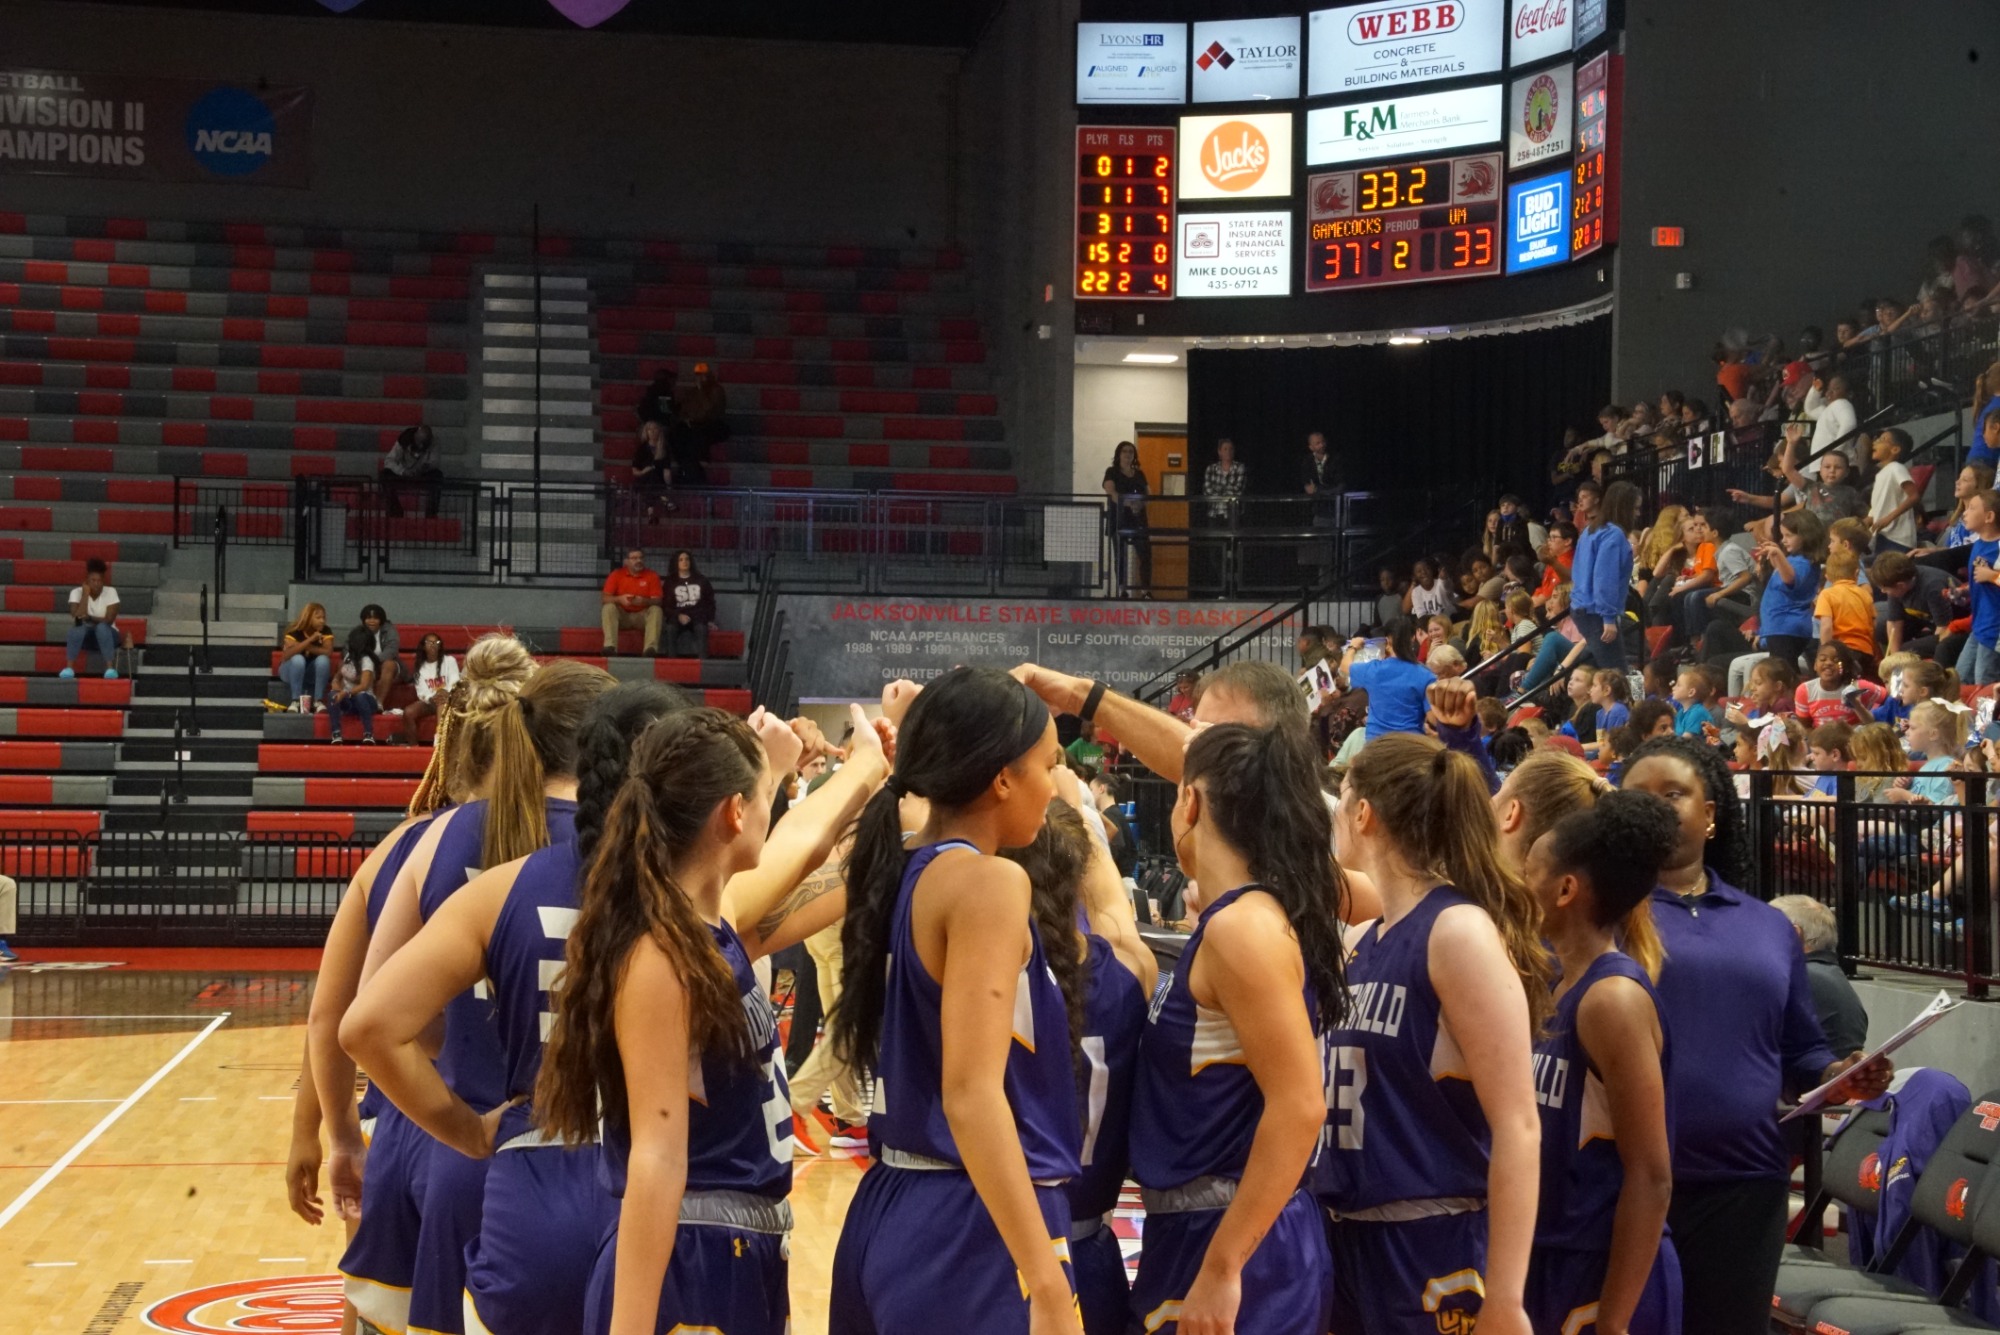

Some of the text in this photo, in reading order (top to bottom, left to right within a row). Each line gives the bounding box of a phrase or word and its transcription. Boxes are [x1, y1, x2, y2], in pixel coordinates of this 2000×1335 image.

[1357, 4, 1456, 41] WEBB
[1237, 44, 1297, 59] TAYLOR
[1373, 42, 1437, 60] CONCRETE
[1400, 58, 1409, 67] &
[1344, 62, 1466, 87] BUILDING MATERIALS
[124, 102, 144, 131] II
[1343, 104, 1398, 141] F&M
[1400, 113, 1461, 129] Merchants Bank
[195, 129, 273, 155] NCAA
[1086, 134, 1163, 146] PLYR FLS PTS
[1206, 131, 1265, 180] Jack's
[1097, 156, 1168, 177] 0 1 2
[1104, 186, 1168, 204] 1 1 7
[1362, 168, 1426, 210] 33.2
[1525, 190, 1554, 216] BUD
[1099, 214, 1167, 234] 3 1 7
[1228, 219, 1283, 229] STATE FARM
[1312, 217, 1382, 240] GAMECOCKS
[1385, 219, 1419, 233] PERIOD
[1519, 208, 1559, 237] LIGHT
[1225, 239, 1285, 248] & FINANCIAL
[1228, 229, 1283, 239] INSURANCE
[1657, 227, 1681, 246] EXIT
[1090, 243, 1167, 263] 15 2 0
[1234, 249, 1277, 258] SERVICES
[1394, 240, 1409, 269] 2
[1454, 228, 1491, 267] 33
[1325, 242, 1361, 280] 37
[1188, 265, 1279, 277] MIKE DOUGLAS
[1081, 271, 1167, 292] 22 2 4
[1207, 279, 1259, 290] 435-6712
[831, 603, 991, 623] JACKSONVILLE
[998, 606, 1063, 625] STATE
[1068, 608, 1171, 627] WOMEN'S
[870, 630, 1006, 644] NCAA APPEARANCES
[1047, 633, 1082, 646] GULF
[1085, 634, 1129, 647] SOUTH
[844, 642, 1030, 657] 1988 1989 1990 1991 1993
[1159, 648, 1187, 659] 1991
